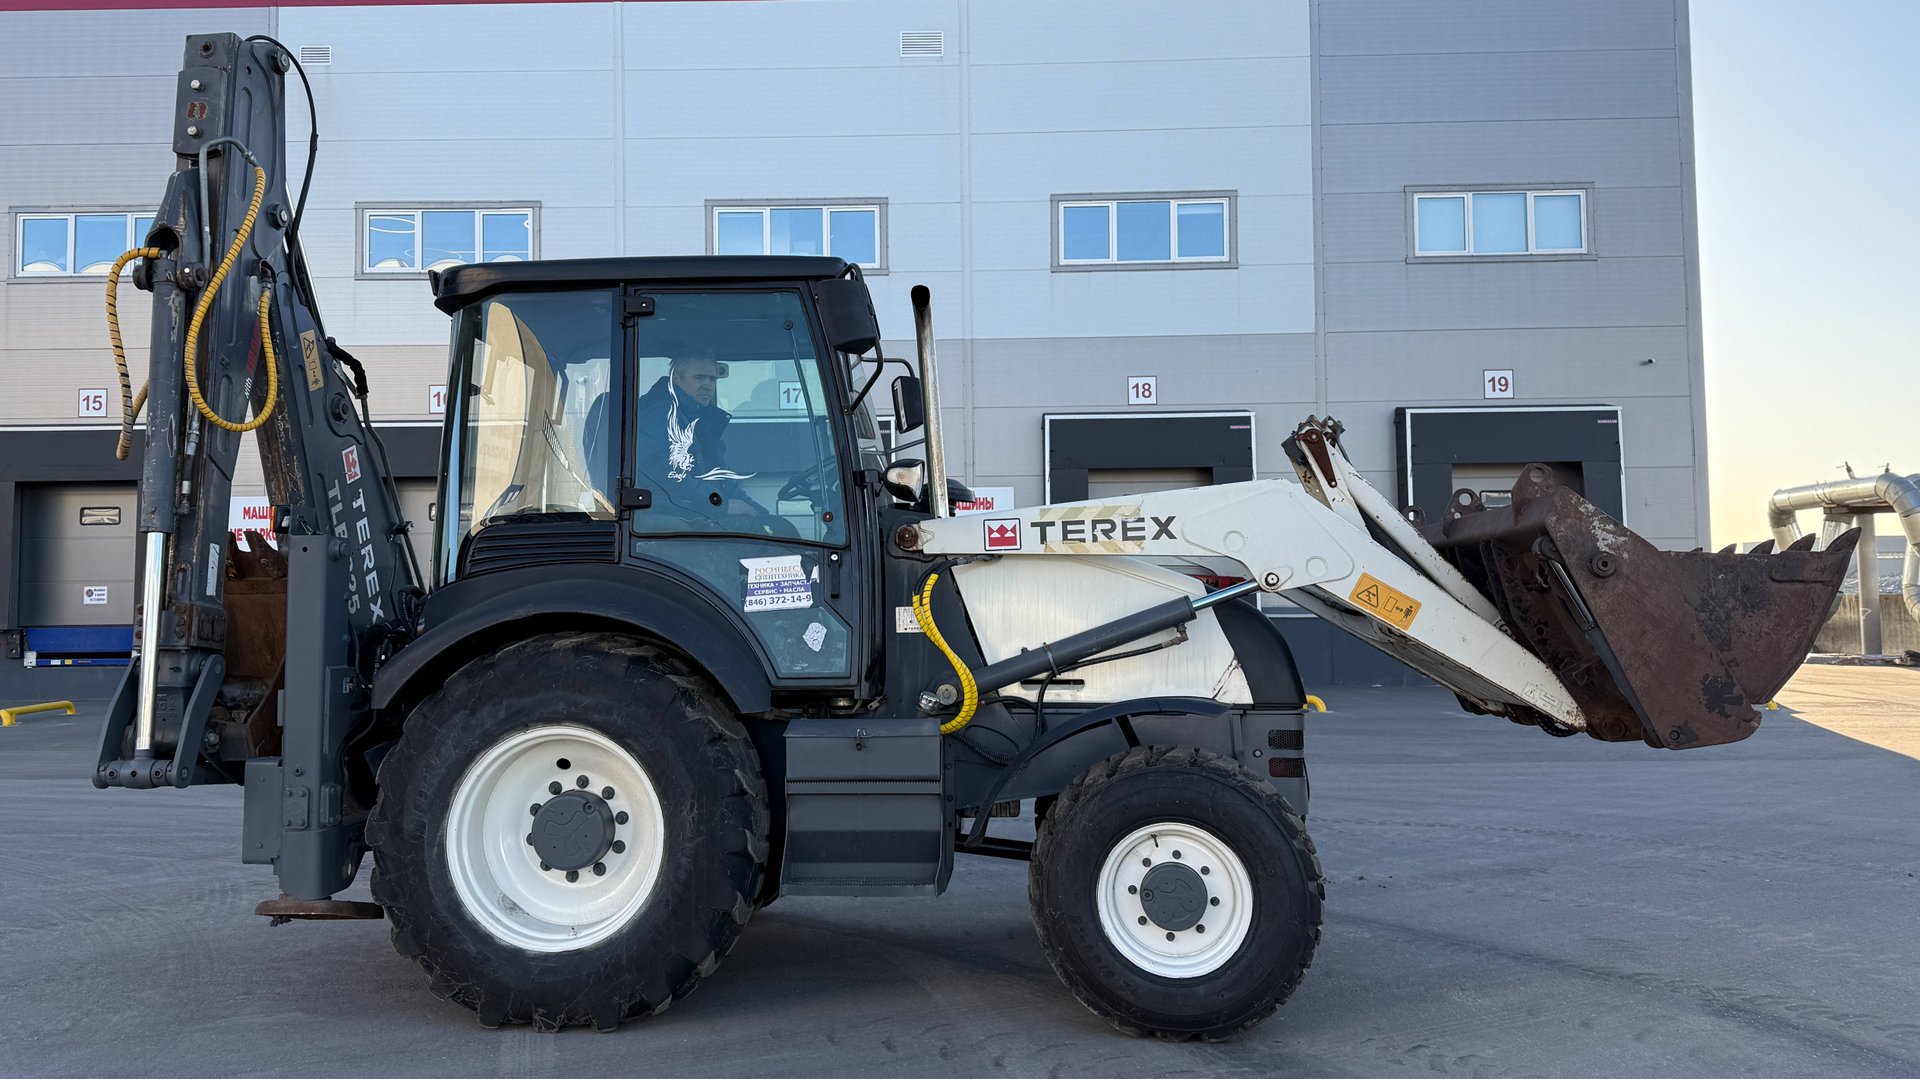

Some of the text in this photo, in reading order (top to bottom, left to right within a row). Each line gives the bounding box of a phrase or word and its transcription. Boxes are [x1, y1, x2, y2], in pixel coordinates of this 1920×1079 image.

[1131, 382, 1152, 399] 18
[1487, 376, 1509, 393] 19
[82, 395, 103, 411] 15
[783, 387, 802, 404] 17
[1030, 515, 1178, 545] TEREX
[352, 488, 385, 625] TEREX
[347, 555, 361, 615] 25
[745, 598, 767, 608] (846)
